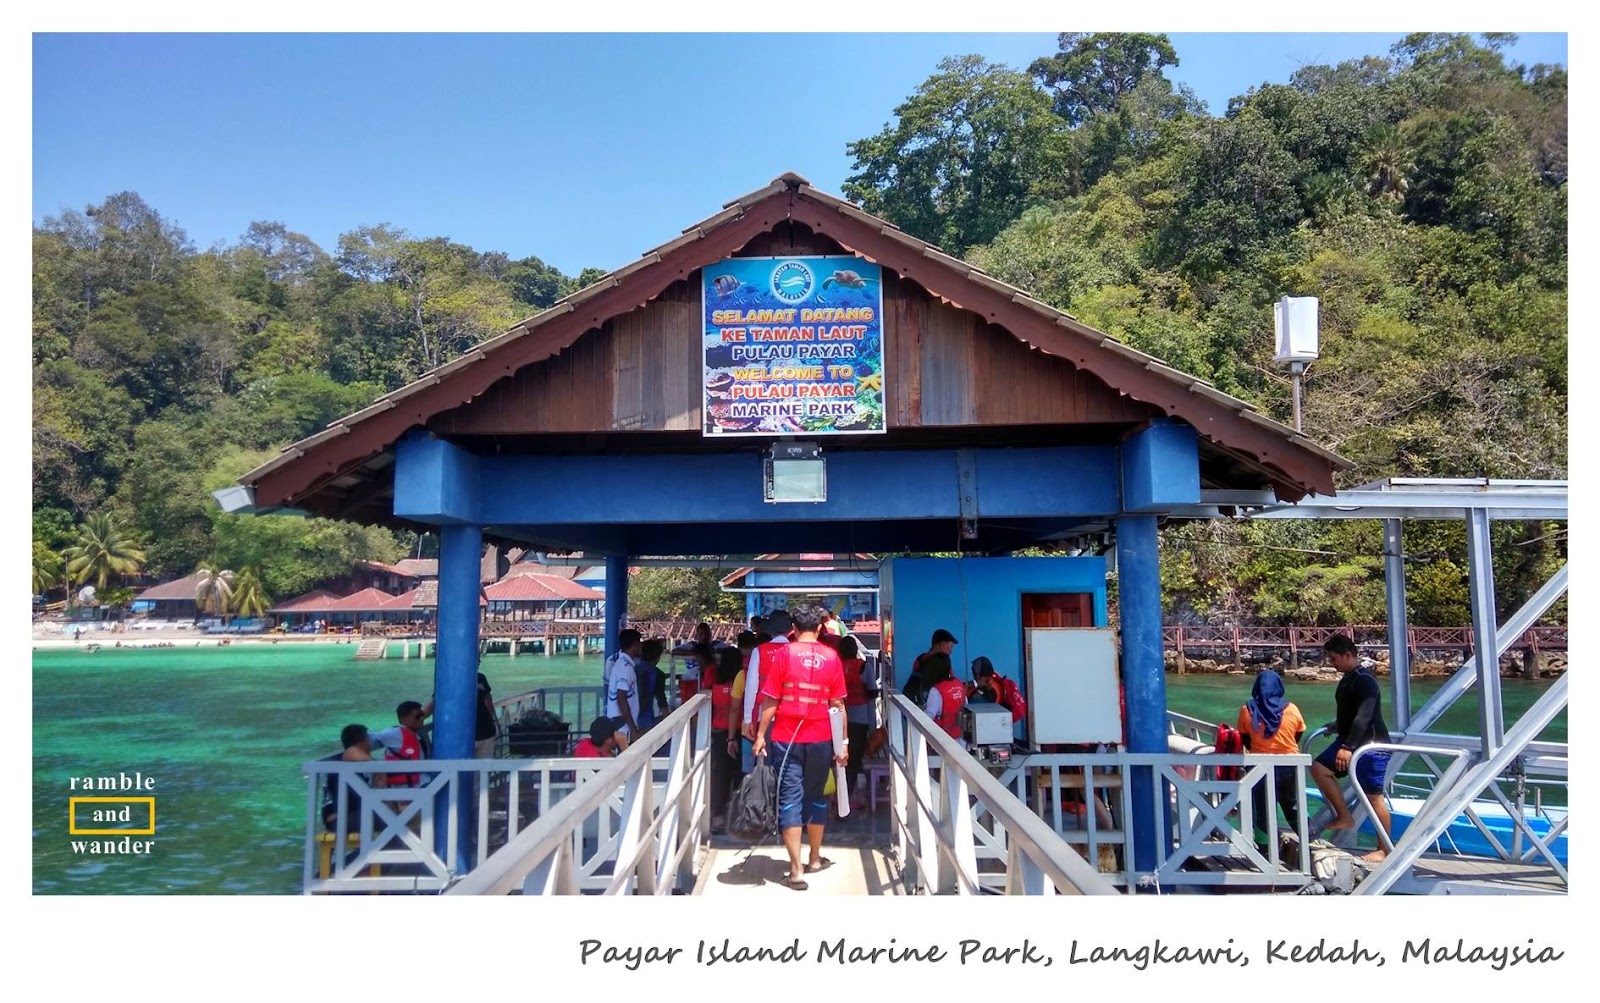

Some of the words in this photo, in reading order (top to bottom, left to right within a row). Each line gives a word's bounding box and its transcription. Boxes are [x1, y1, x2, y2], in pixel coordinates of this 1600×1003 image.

[713, 309, 797, 325] SELAMAT
[801, 307, 874, 323] DATANG
[721, 329, 746, 342] KE
[751, 327, 814, 342] TAMAN
[818, 326, 867, 341] LAUT
[732, 346, 793, 360] PULAU
[798, 345, 855, 358] PAYAR
[733, 366, 825, 381] WELCOME
[828, 365, 854, 379] TO
[732, 385, 793, 399] PULAU
[798, 384, 855, 397] PAYAR
[732, 404, 804, 417] MARINE
[808, 402, 857, 416] PARK
